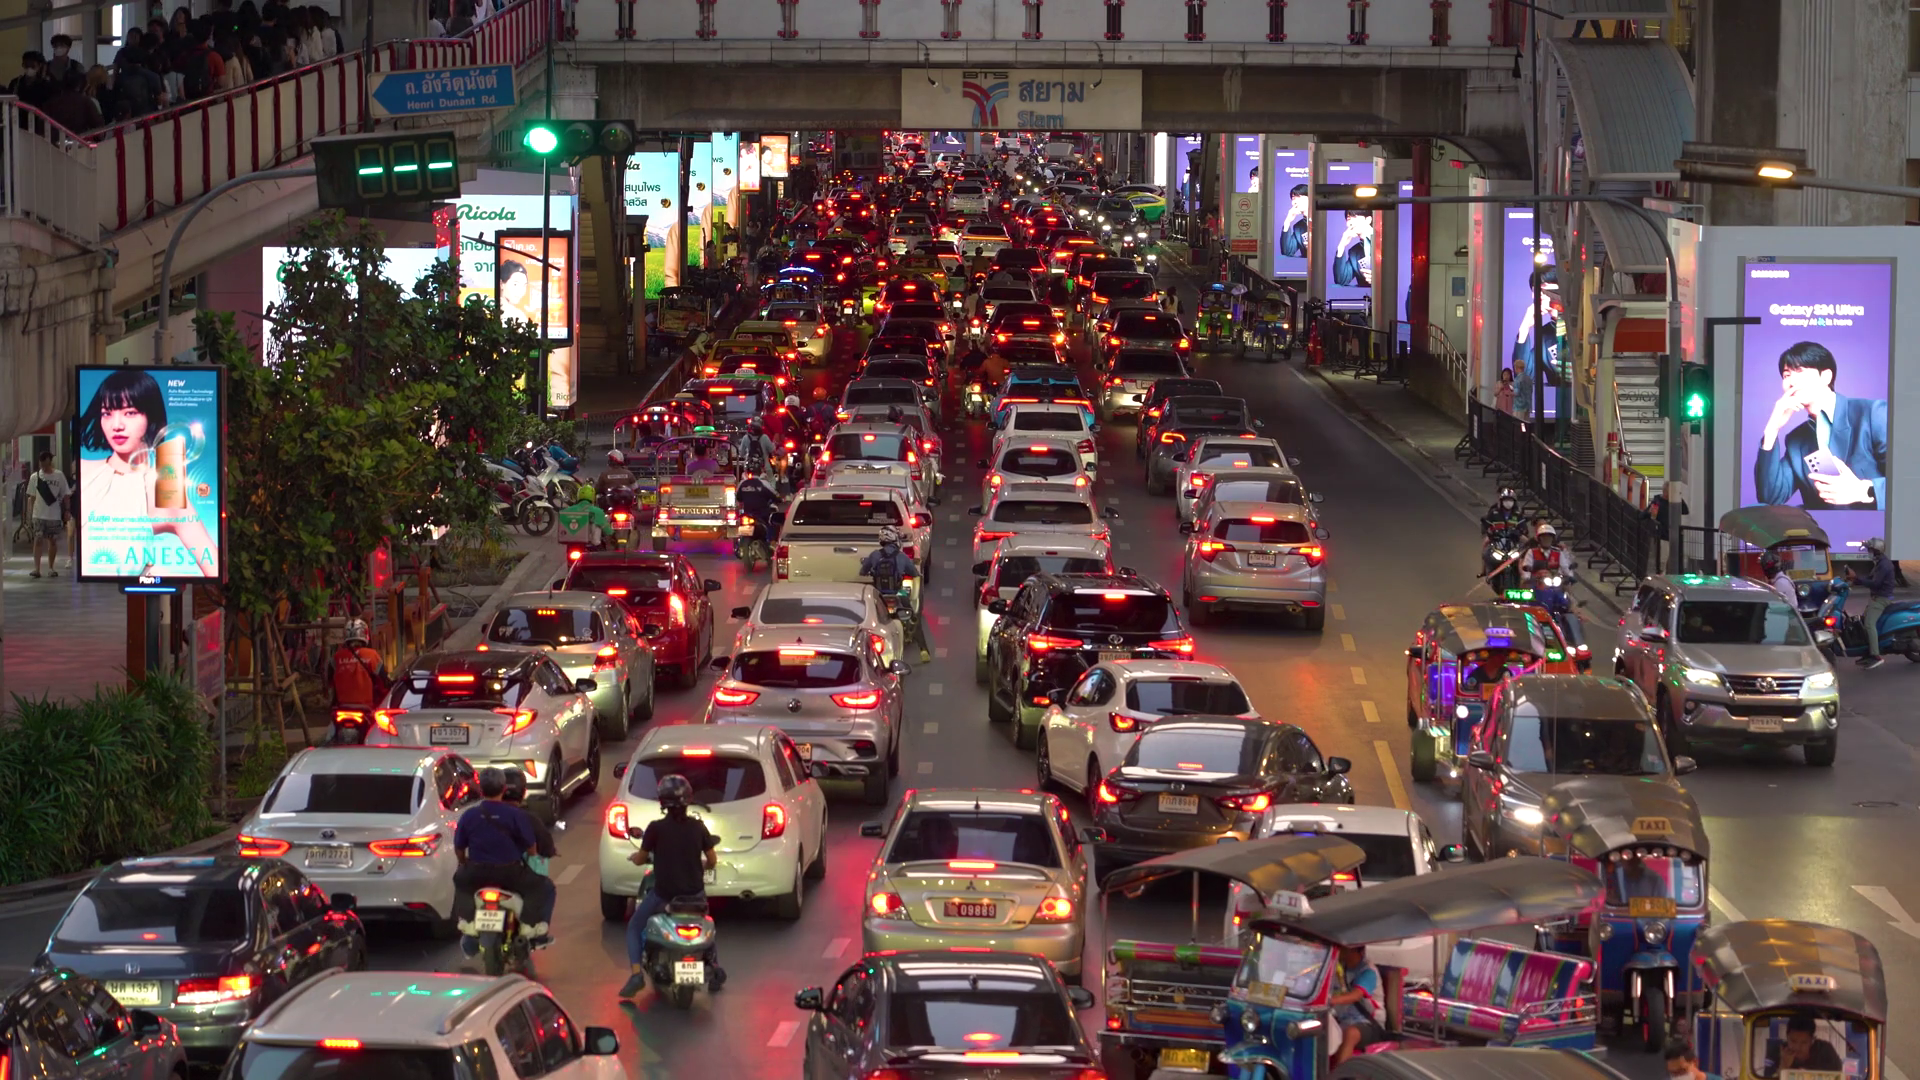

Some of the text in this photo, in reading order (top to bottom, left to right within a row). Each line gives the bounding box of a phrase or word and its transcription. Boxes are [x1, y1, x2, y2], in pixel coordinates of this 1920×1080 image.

[962, 71, 1009, 80] BTS
[1018, 79, 1085, 103] สยาม
[407, 95, 498, 110] Henri Dunant Rd.
[1017, 111, 1064, 129] Siam
[456, 203, 517, 221] Ricola
[1769, 303, 1864, 317] Galaxy S24 Ultra
[1780, 317, 1808, 327] Galaxy
[168, 379, 186, 387] NEW
[124, 546, 214, 565] ANESSA
[1639, 820, 1667, 831] TAXI
[1797, 975, 1829, 986] TAXI
[130, 982, 157, 994] 1357
